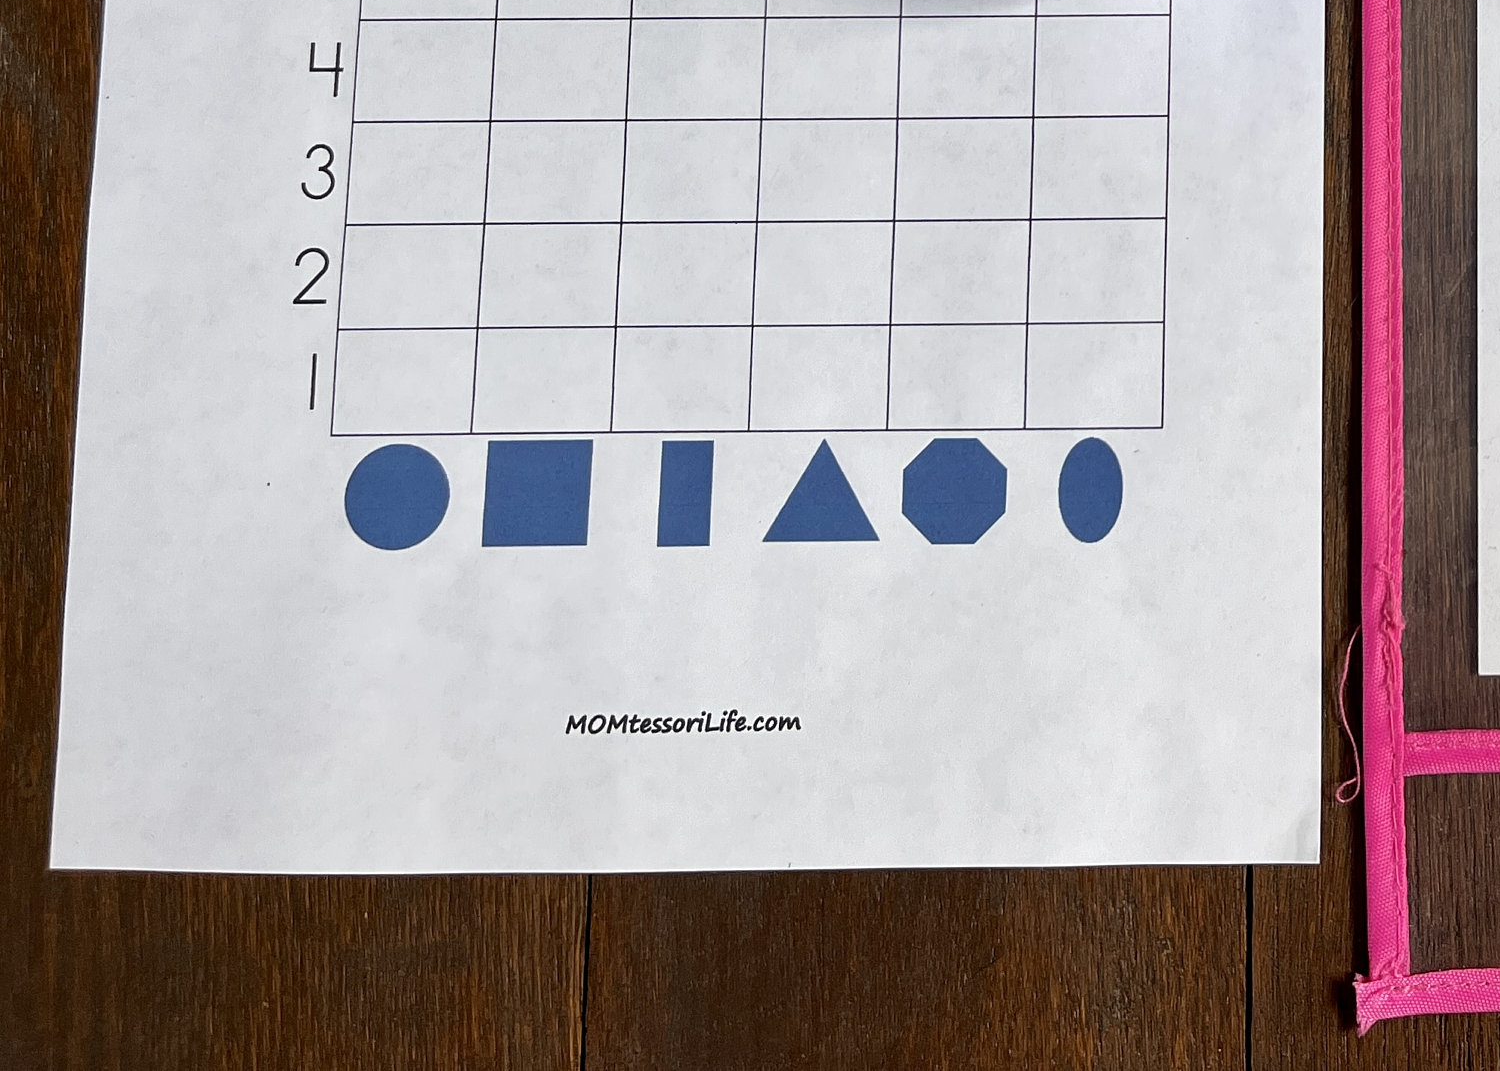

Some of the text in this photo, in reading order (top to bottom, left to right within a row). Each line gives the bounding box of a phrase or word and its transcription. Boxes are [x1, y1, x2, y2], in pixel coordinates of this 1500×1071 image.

[309, 42, 344, 98] 4
[301, 143, 335, 200] 3
[292, 247, 330, 305] 2
[308, 353, 317, 411] 1
[565, 709, 802, 735] MOMtessoriLife.com
